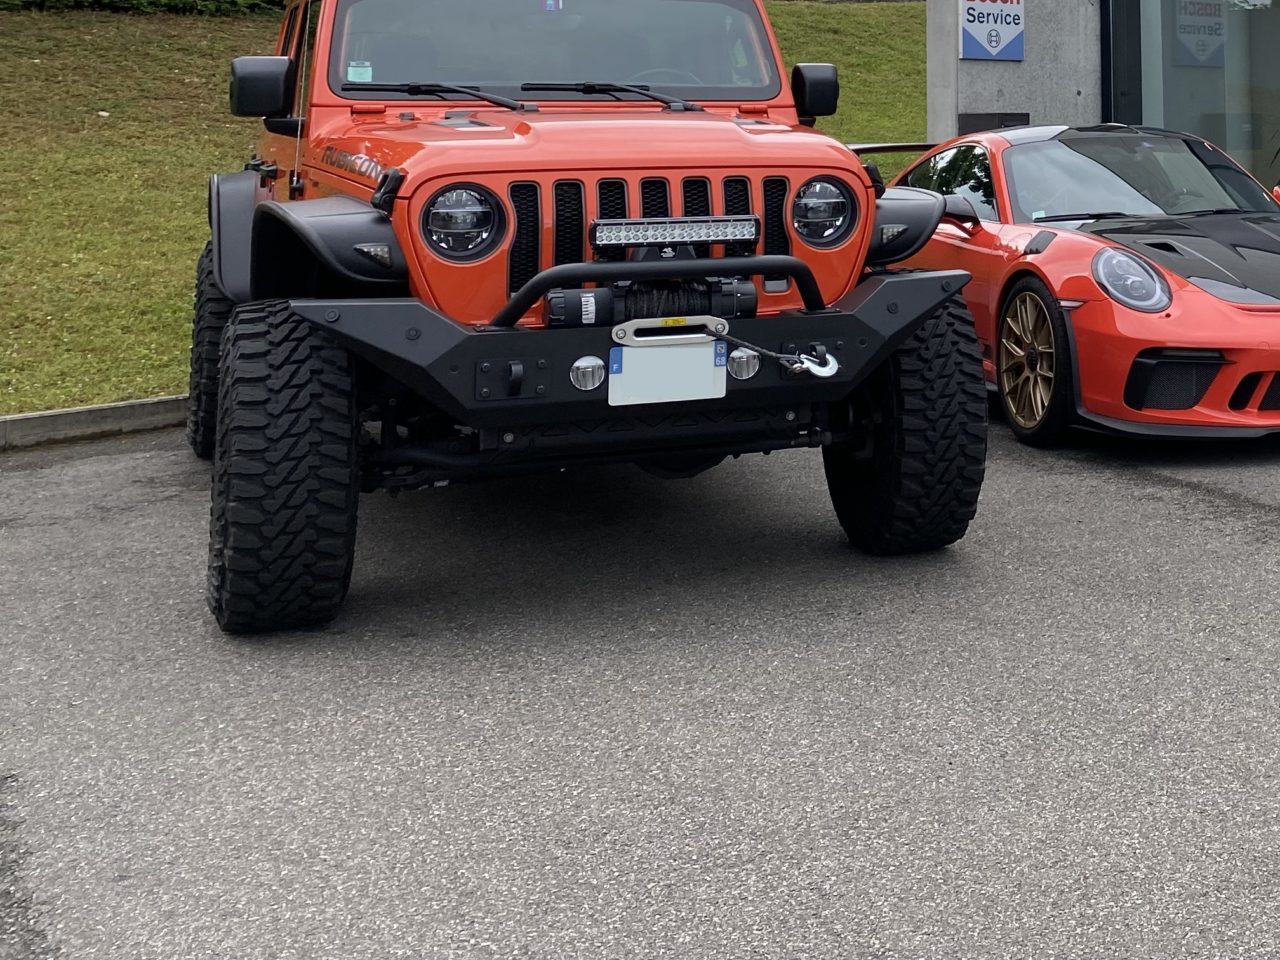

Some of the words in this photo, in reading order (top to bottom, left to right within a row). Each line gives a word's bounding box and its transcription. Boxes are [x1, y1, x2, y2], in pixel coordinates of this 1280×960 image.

[966, 7, 1021, 26] Service
[715, 356, 727, 366] 68
[612, 363, 619, 372] F
